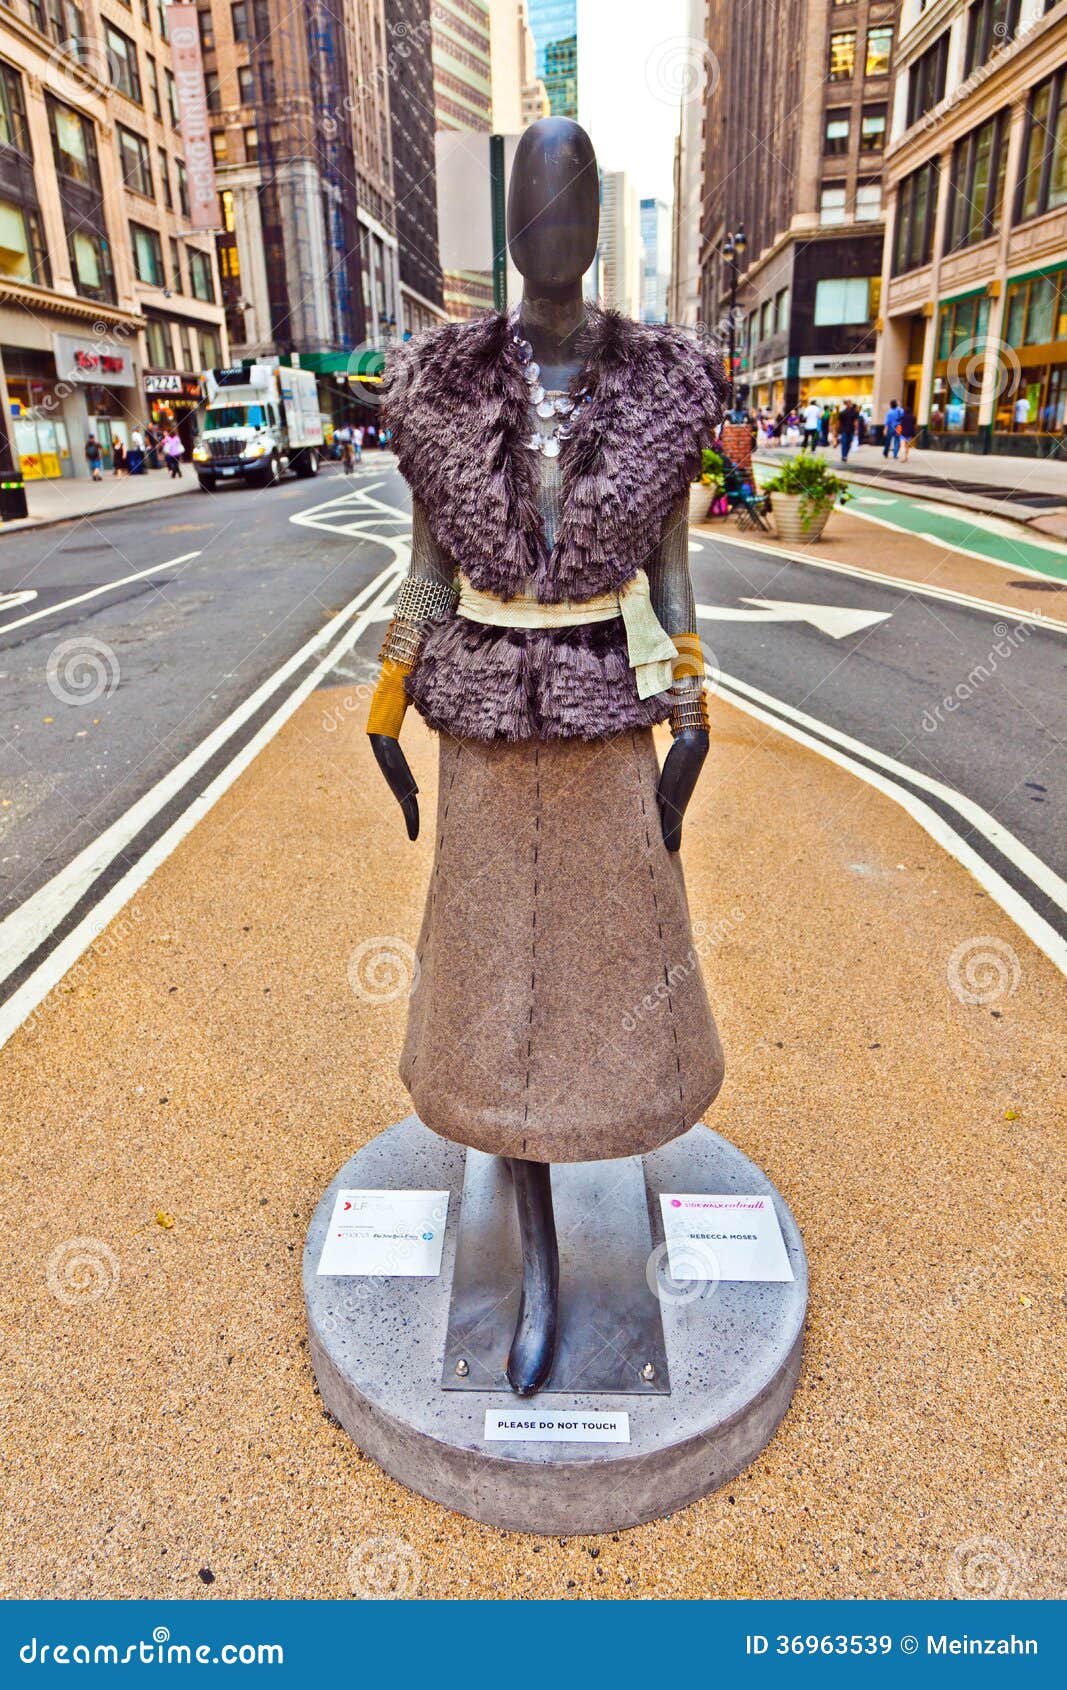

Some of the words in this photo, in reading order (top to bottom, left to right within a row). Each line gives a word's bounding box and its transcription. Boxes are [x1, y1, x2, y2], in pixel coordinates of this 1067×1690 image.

[145, 376, 180, 391] PIZZA
[497, 1421, 536, 1429] PLEASE
[557, 1422, 579, 1430] NOT
[583, 1422, 617, 1430] TOUCH
